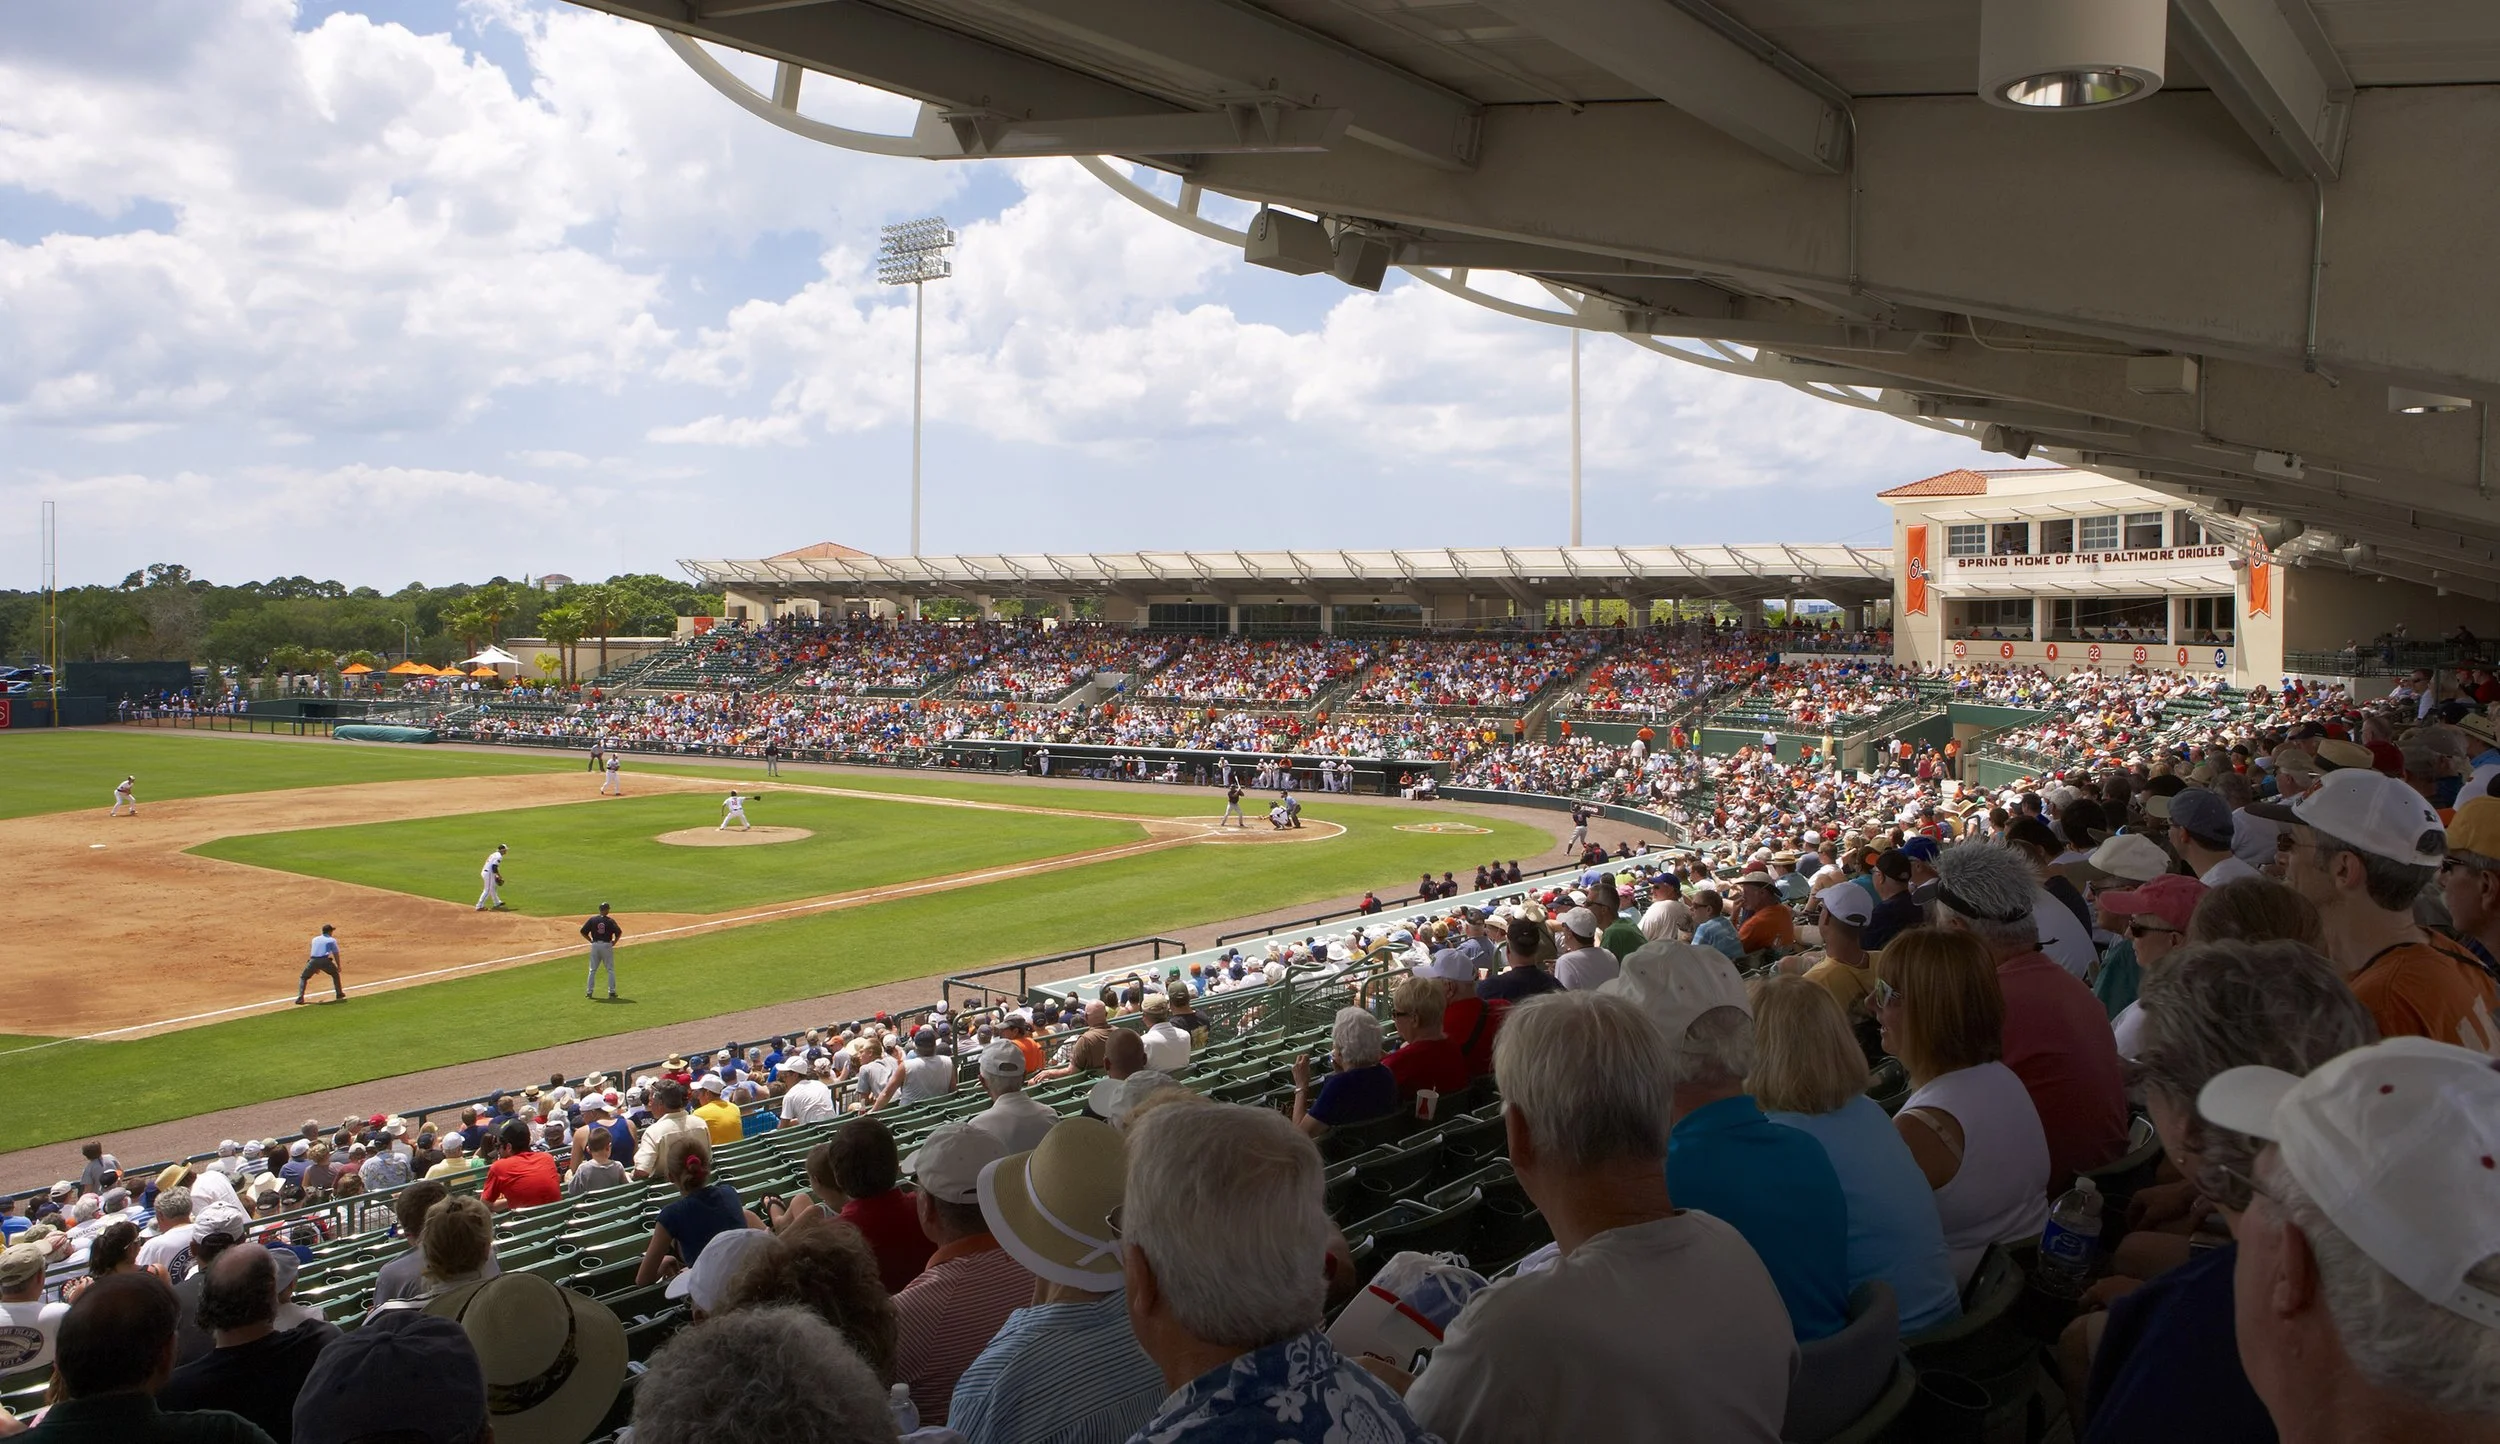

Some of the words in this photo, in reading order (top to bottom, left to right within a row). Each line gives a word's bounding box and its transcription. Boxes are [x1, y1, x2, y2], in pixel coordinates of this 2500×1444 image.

[1958, 557, 2008, 568] SPRING
[2014, 556, 2050, 566] HOME
[2055, 555, 2071, 565] OF
[2075, 553, 2099, 564] THE
[2104, 550, 2174, 563] BALTIMORE
[2178, 546, 2225, 559] ORIOLES
[1954, 644, 1965, 655] 20
[2004, 644, 2010, 656] 5
[2049, 647, 2054, 658] 4
[2089, 648, 2099, 659] 22
[2134, 649, 2145, 661] 33
[2180, 651, 2185, 663] 8
[2215, 652, 2225, 665] 42
[171, 1254, 186, 1277] LIDO
